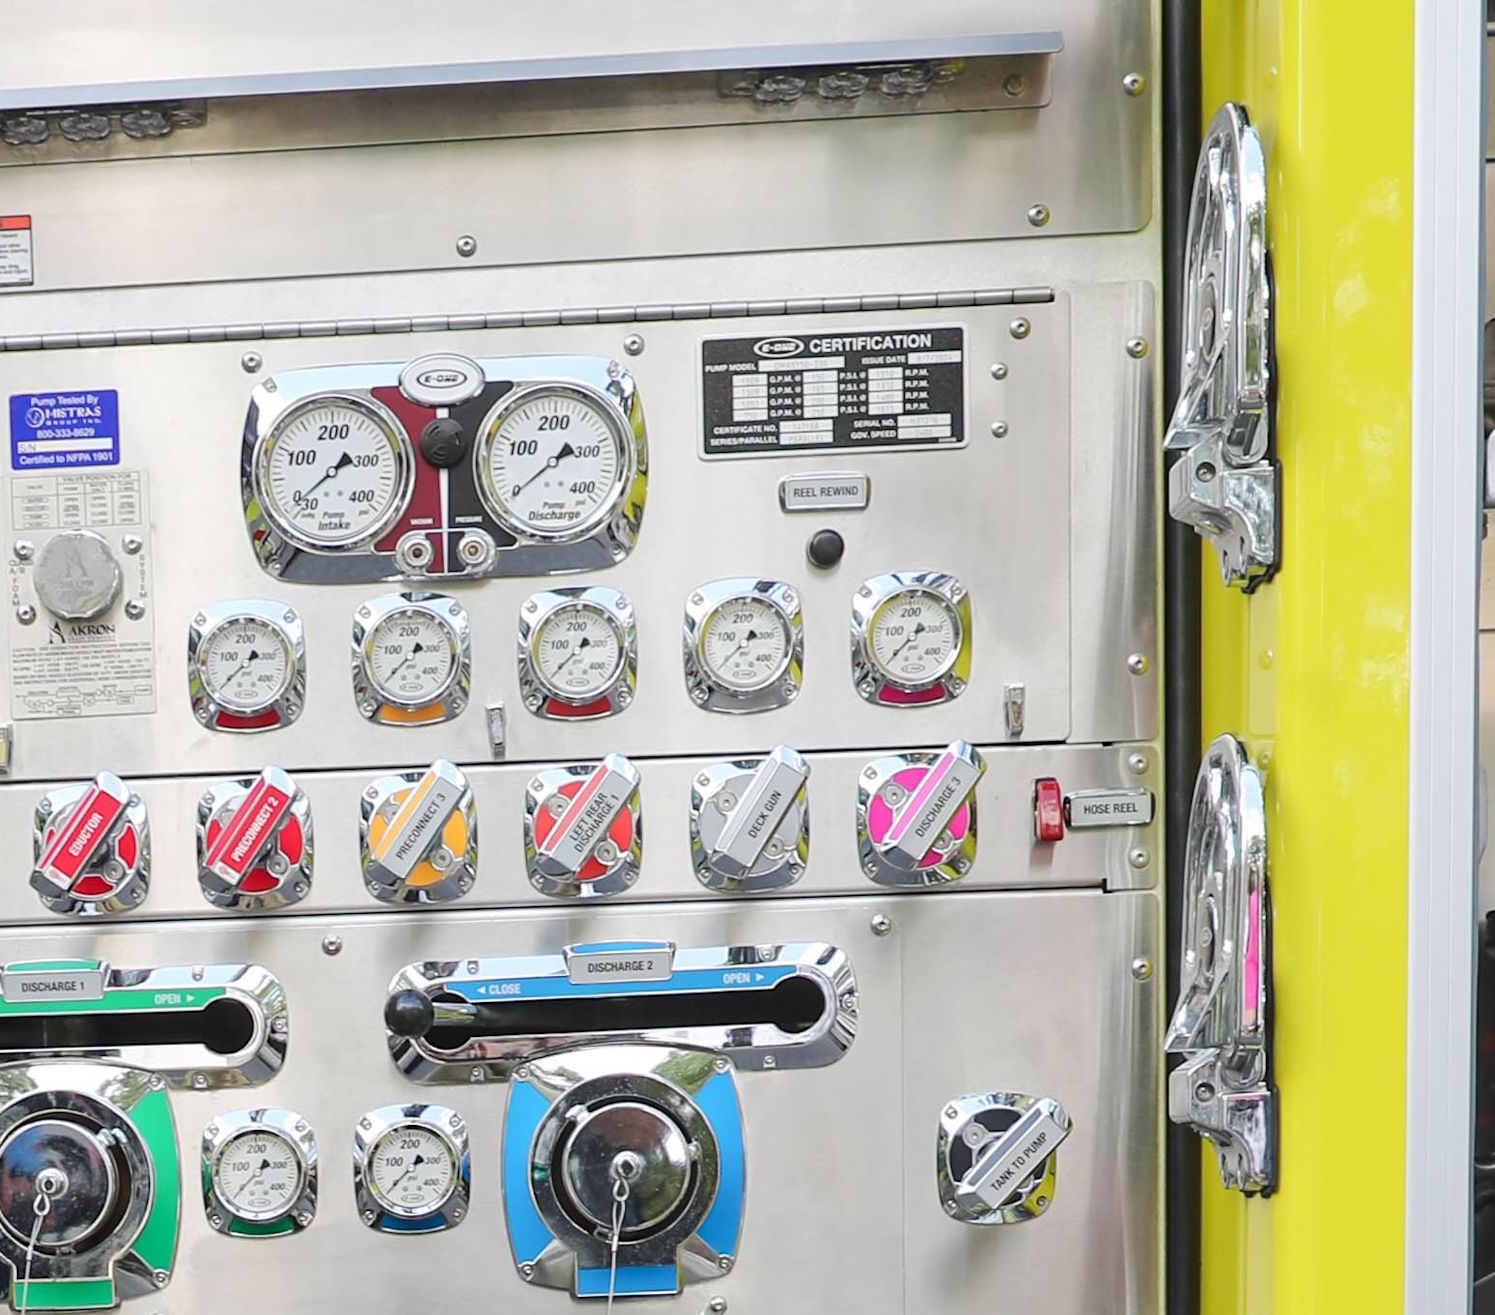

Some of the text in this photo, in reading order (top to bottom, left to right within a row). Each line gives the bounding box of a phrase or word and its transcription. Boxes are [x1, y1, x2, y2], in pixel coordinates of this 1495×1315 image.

[810, 334, 932, 353] CERTIFICATION
[704, 355, 906, 372] PUMP MODEL ISSUE DATE
[30, 394, 100, 406] Pump Tested By
[45, 406, 102, 418] MISTRAS
[538, 416, 570, 431] 200
[714, 418, 896, 434] CERTIFICATE NO. SERIAL NO.
[317, 424, 350, 440] 200
[850, 431, 870, 440] GOV.
[871, 430, 896, 438] SPEED
[508, 440, 600, 458] 100 300
[19, 452, 113, 465] Certified to NFPA 1901
[288, 450, 378, 468] 100 300
[570, 481, 596, 494] 400
[793, 486, 858, 498] REEL REWIND
[349, 490, 374, 502] 400
[542, 501, 566, 510] Pump
[322, 512, 345, 521] Pump
[528, 510, 582, 521] Discharge
[318, 519, 352, 531] Intake
[733, 614, 754, 624] 200
[901, 608, 922, 618] 200
[69, 624, 116, 636] AKRON
[399, 627, 420, 636] 200
[566, 622, 586, 632] 200
[885, 626, 904, 636] 100
[235, 634, 256, 644] 200
[717, 632, 736, 642] 100
[384, 646, 402, 654] 100
[550, 640, 569, 650] 100
[220, 652, 238, 662] 100
[914, 776, 962, 838] DISCHARGE 3
[1084, 802, 1138, 814] HOSE REEL
[569, 792, 608, 842] LEFT REAR
[748, 790, 782, 840] DECK GUN
[230, 796, 279, 862] PRECONNECT 2
[396, 792, 447, 861] PRECONNECT 3
[574, 794, 620, 853] DISCHARGE 1
[69, 812, 103, 857] EDUCTOR
[588, 960, 654, 974] DISCHARGE 2
[722, 972, 750, 984] OPEN
[21, 981, 85, 992] DISCHARGE 1
[488, 984, 521, 996] CLOSE
[154, 992, 180, 1004] OPEN
[246, 1144, 266, 1154] 200
[400, 1139, 420, 1149] 200
[231, 1162, 250, 1172] 100
[384, 1157, 404, 1166] 100
[991, 1132, 1048, 1191] TANK TO PUMP
